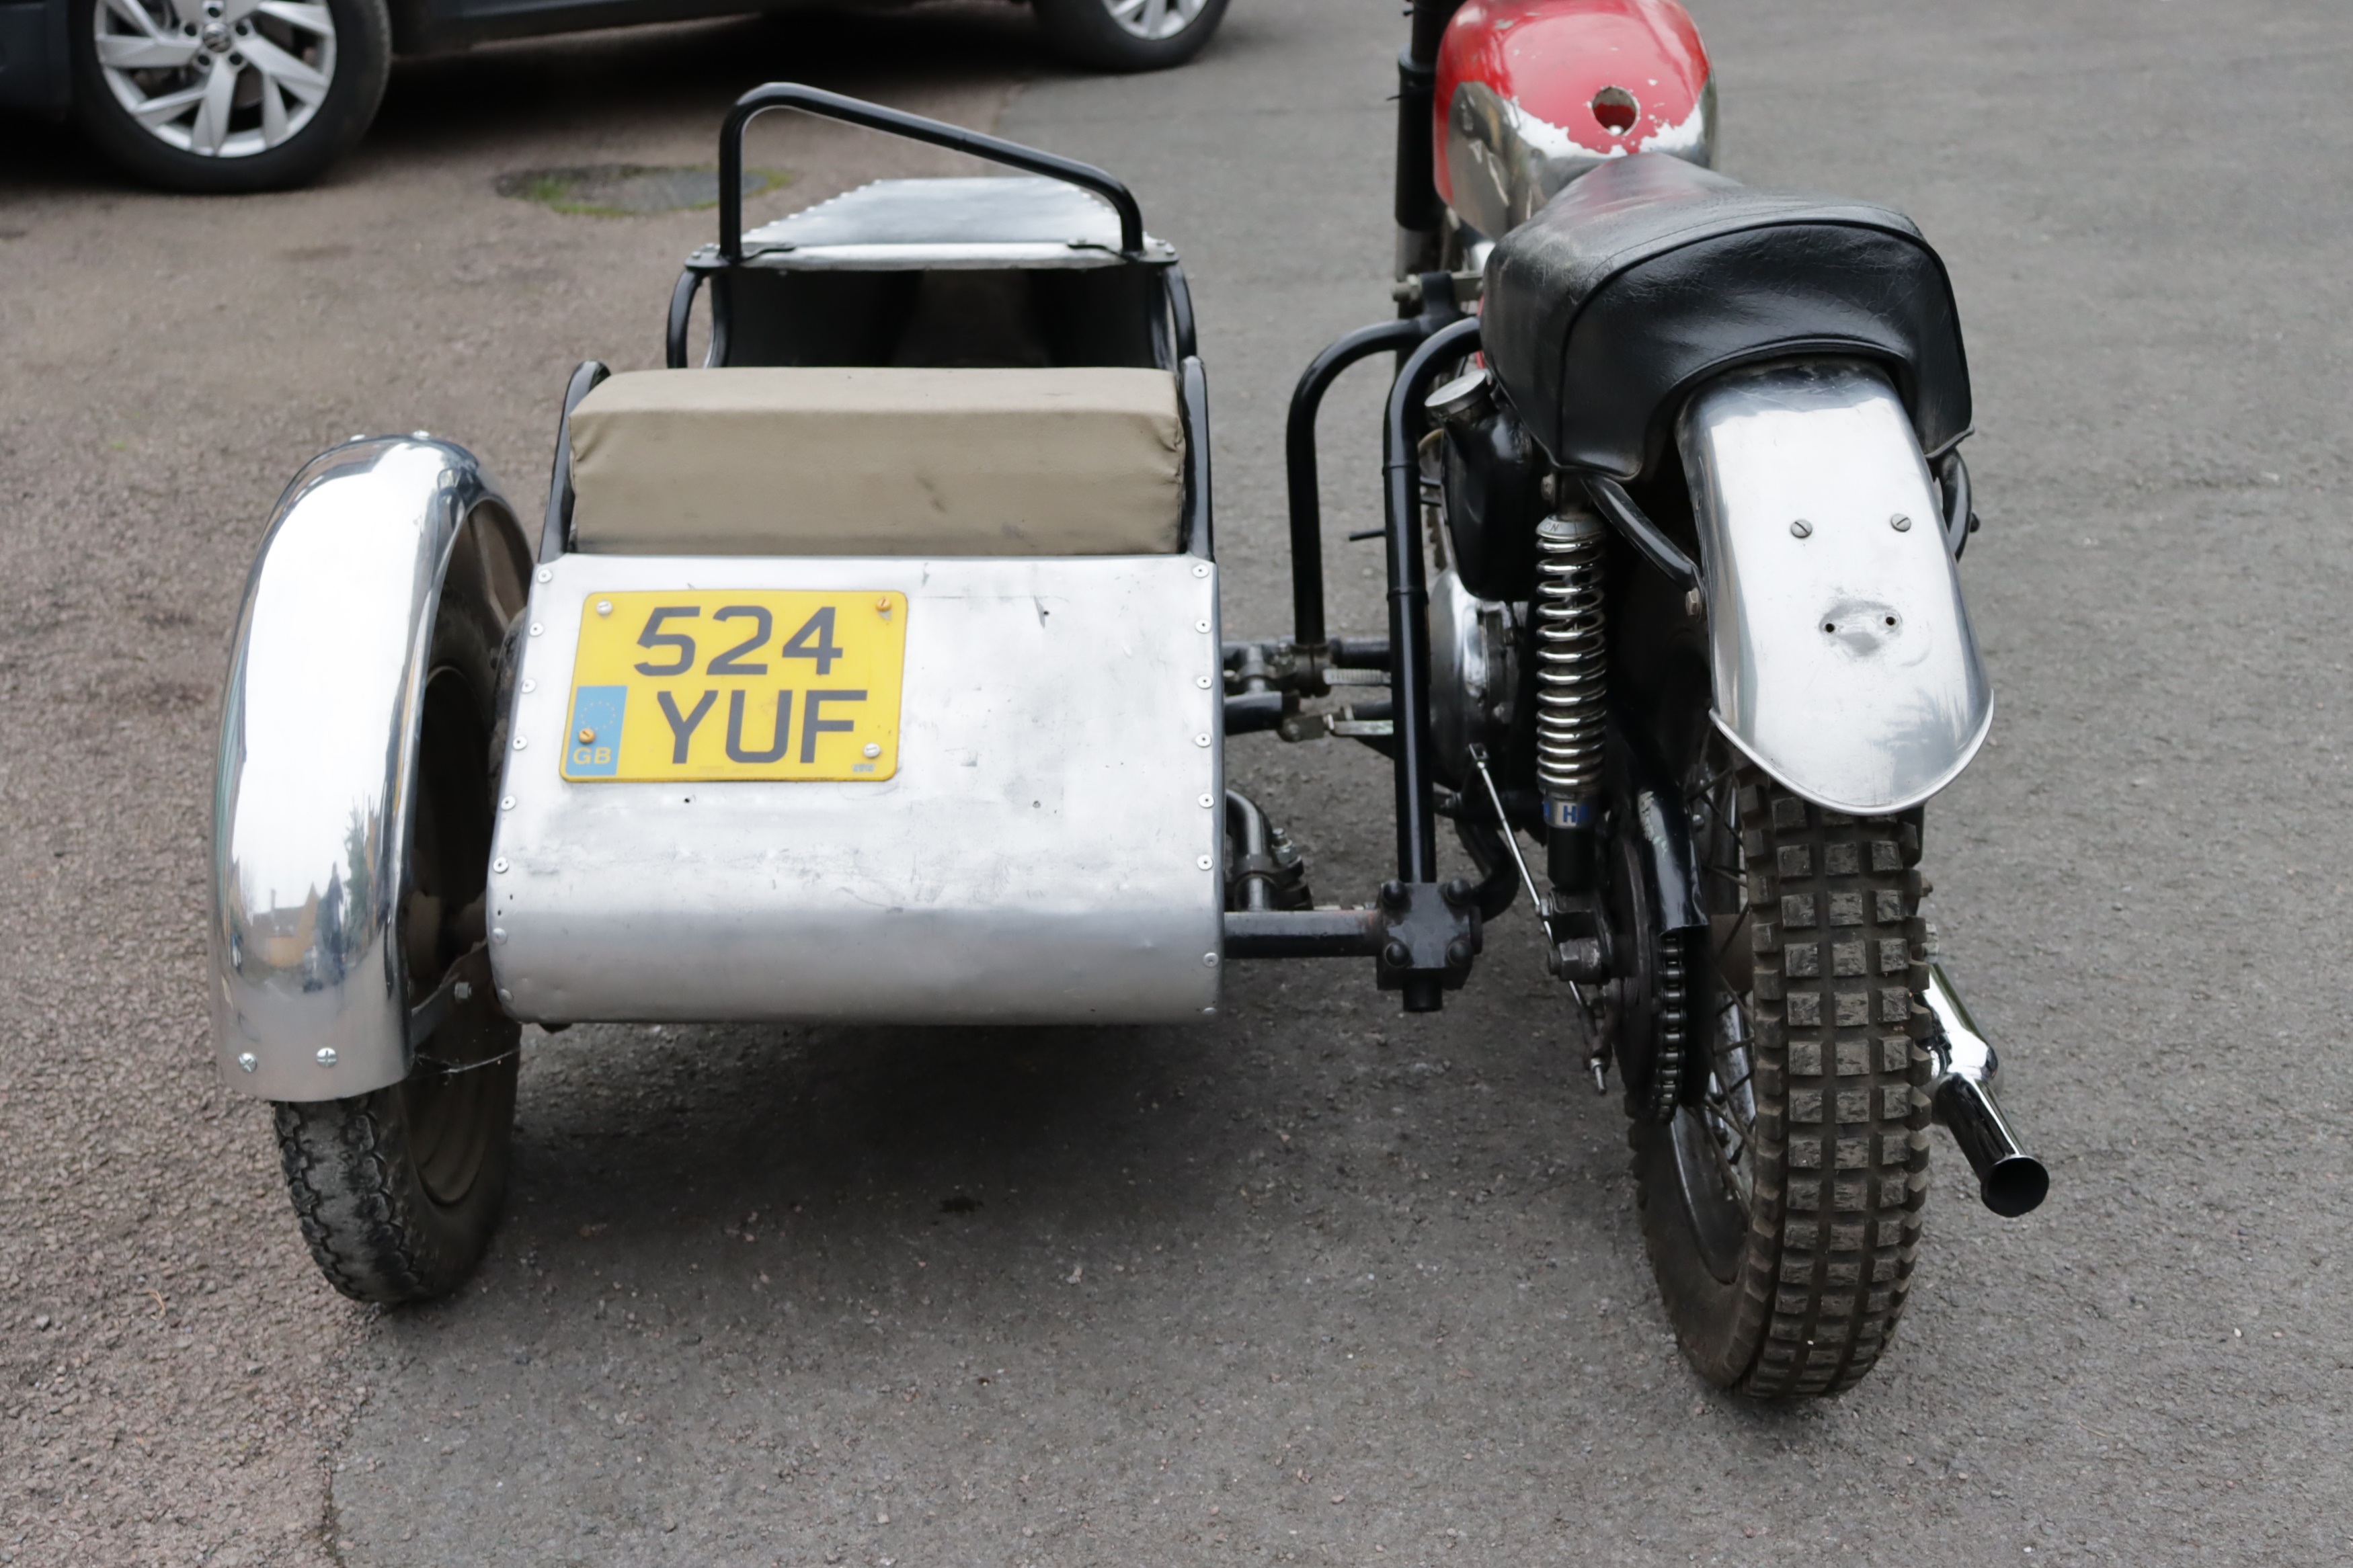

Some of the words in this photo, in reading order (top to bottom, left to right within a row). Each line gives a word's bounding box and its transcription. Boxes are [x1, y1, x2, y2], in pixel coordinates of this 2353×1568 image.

[634, 606, 843, 676] 524
[573, 747, 611, 764] GB
[657, 690, 867, 764] YUF
